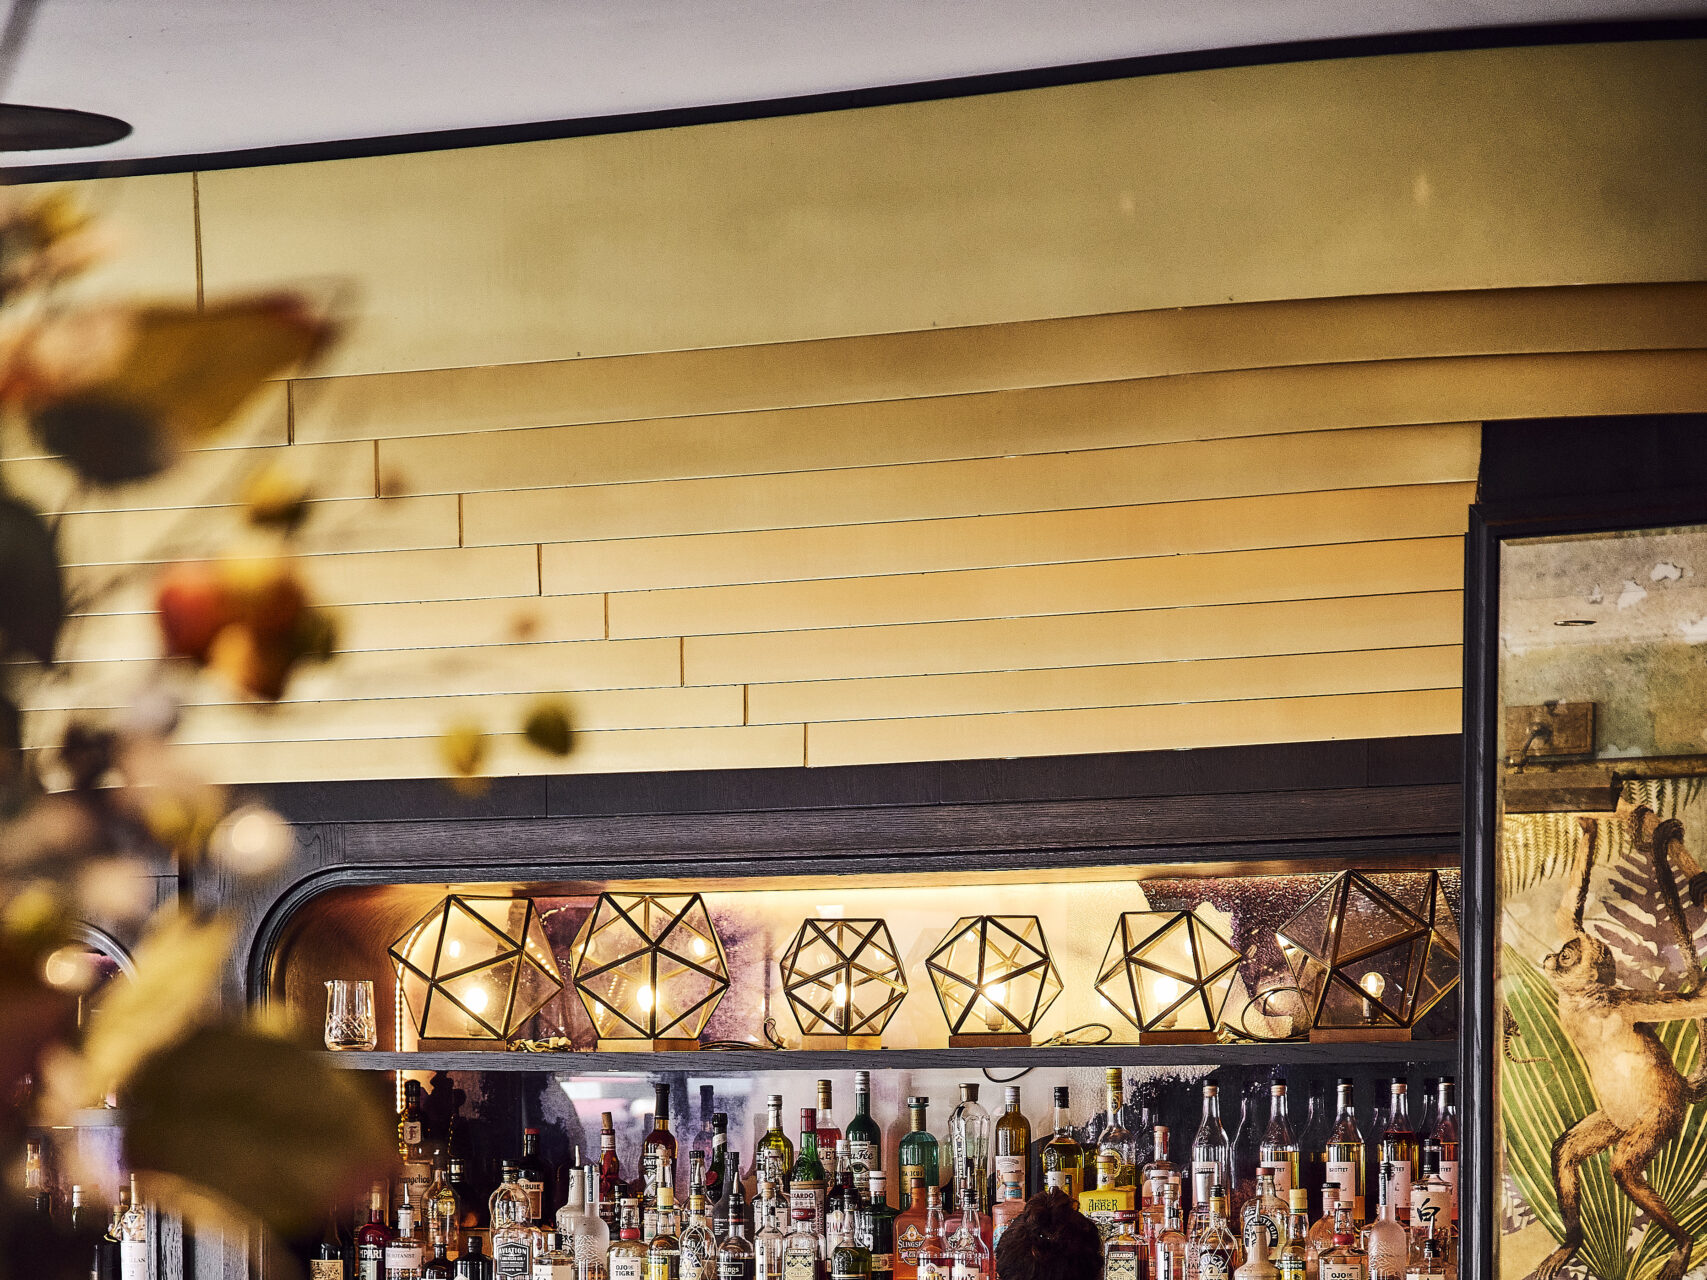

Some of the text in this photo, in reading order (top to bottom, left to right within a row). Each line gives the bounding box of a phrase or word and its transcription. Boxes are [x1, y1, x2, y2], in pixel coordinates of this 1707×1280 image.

[1088, 1198, 1118, 1212] ARBER
[1416, 1197, 1441, 1223] 白
[499, 1247, 527, 1255] AVIATION
